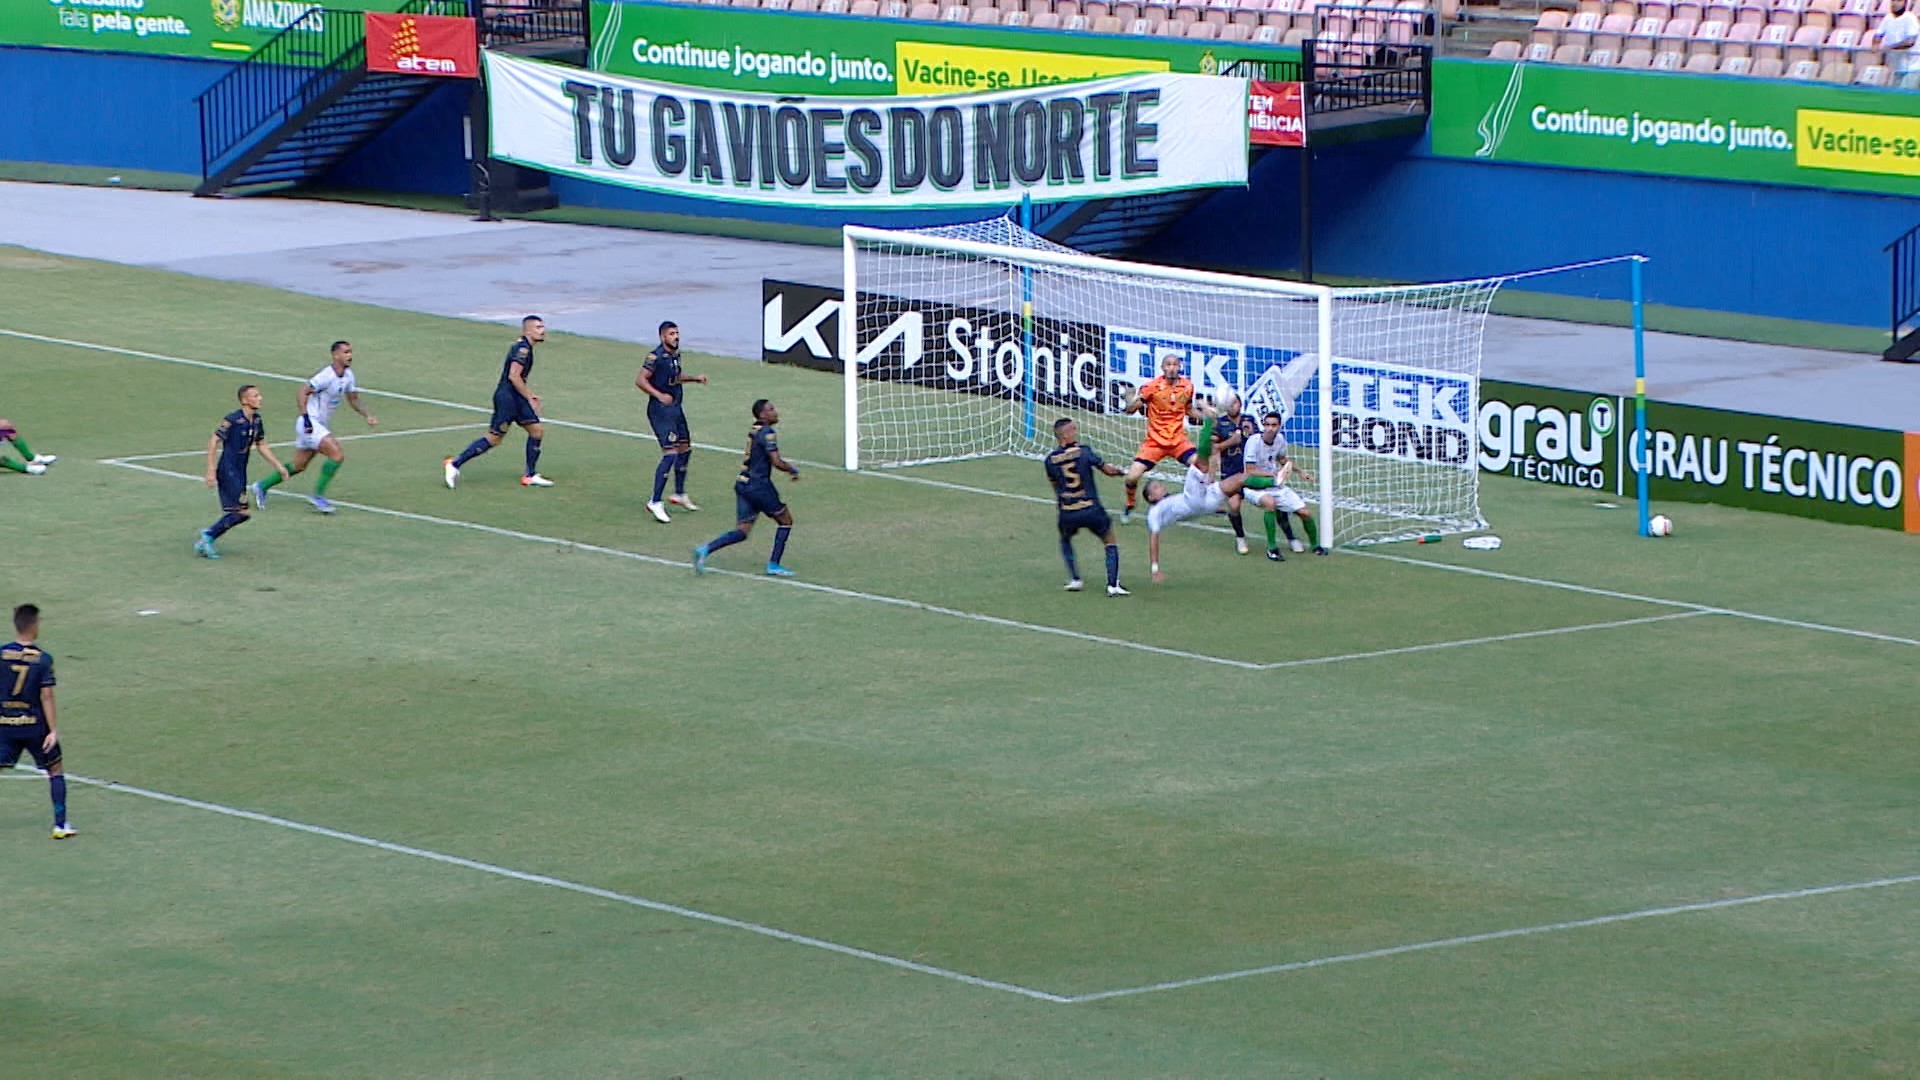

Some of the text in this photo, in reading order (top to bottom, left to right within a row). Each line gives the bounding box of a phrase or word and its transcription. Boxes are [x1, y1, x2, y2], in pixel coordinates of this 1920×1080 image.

[92, 11, 132, 33] pela
[135, 16, 191, 36] gente.
[242, 0, 324, 32] AMAZONAS
[397, 56, 456, 72] atem
[632, 38, 894, 83] Continue jogando junto.
[562, 80, 1160, 193] TU GAVIÕES DO NORTE
[1530, 105, 1793, 151] Continue jogando junto.
[946, 316, 1097, 400] Stonic
[1338, 373, 1465, 424] TEK
[1331, 411, 1469, 463] BOND
[1479, 401, 1603, 472] grau
[1062, 462, 1081, 488] 5
[1511, 455, 1604, 489] TÉCNICO
[1629, 428, 1902, 509] GRAU TÉCNICO
[11, 665, 29, 696] 7
